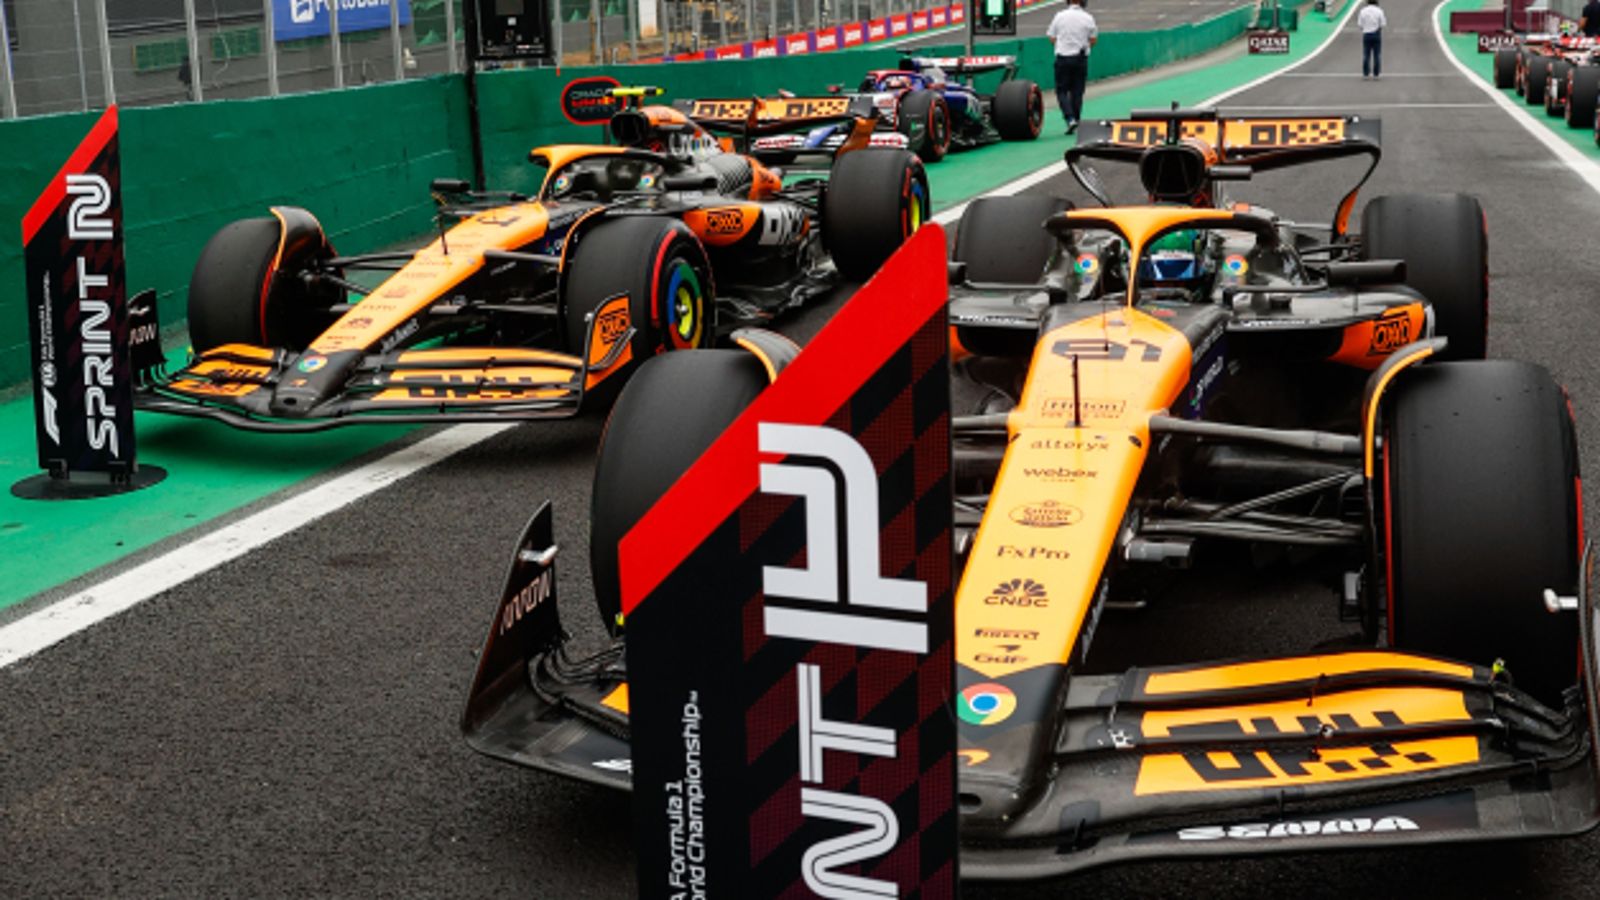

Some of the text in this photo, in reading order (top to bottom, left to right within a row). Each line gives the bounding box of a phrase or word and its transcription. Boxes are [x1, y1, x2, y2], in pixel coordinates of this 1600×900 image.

[1251, 122, 1338, 145] OKX
[76, 257, 119, 458] SPRINT
[1031, 439, 1109, 452] alteryx
[1024, 467, 1098, 478] webex
[997, 545, 1070, 560] FxPro
[984, 596, 1050, 607] CNBC
[665, 780, 683, 794] 1
[667, 796, 686, 888] Formula
